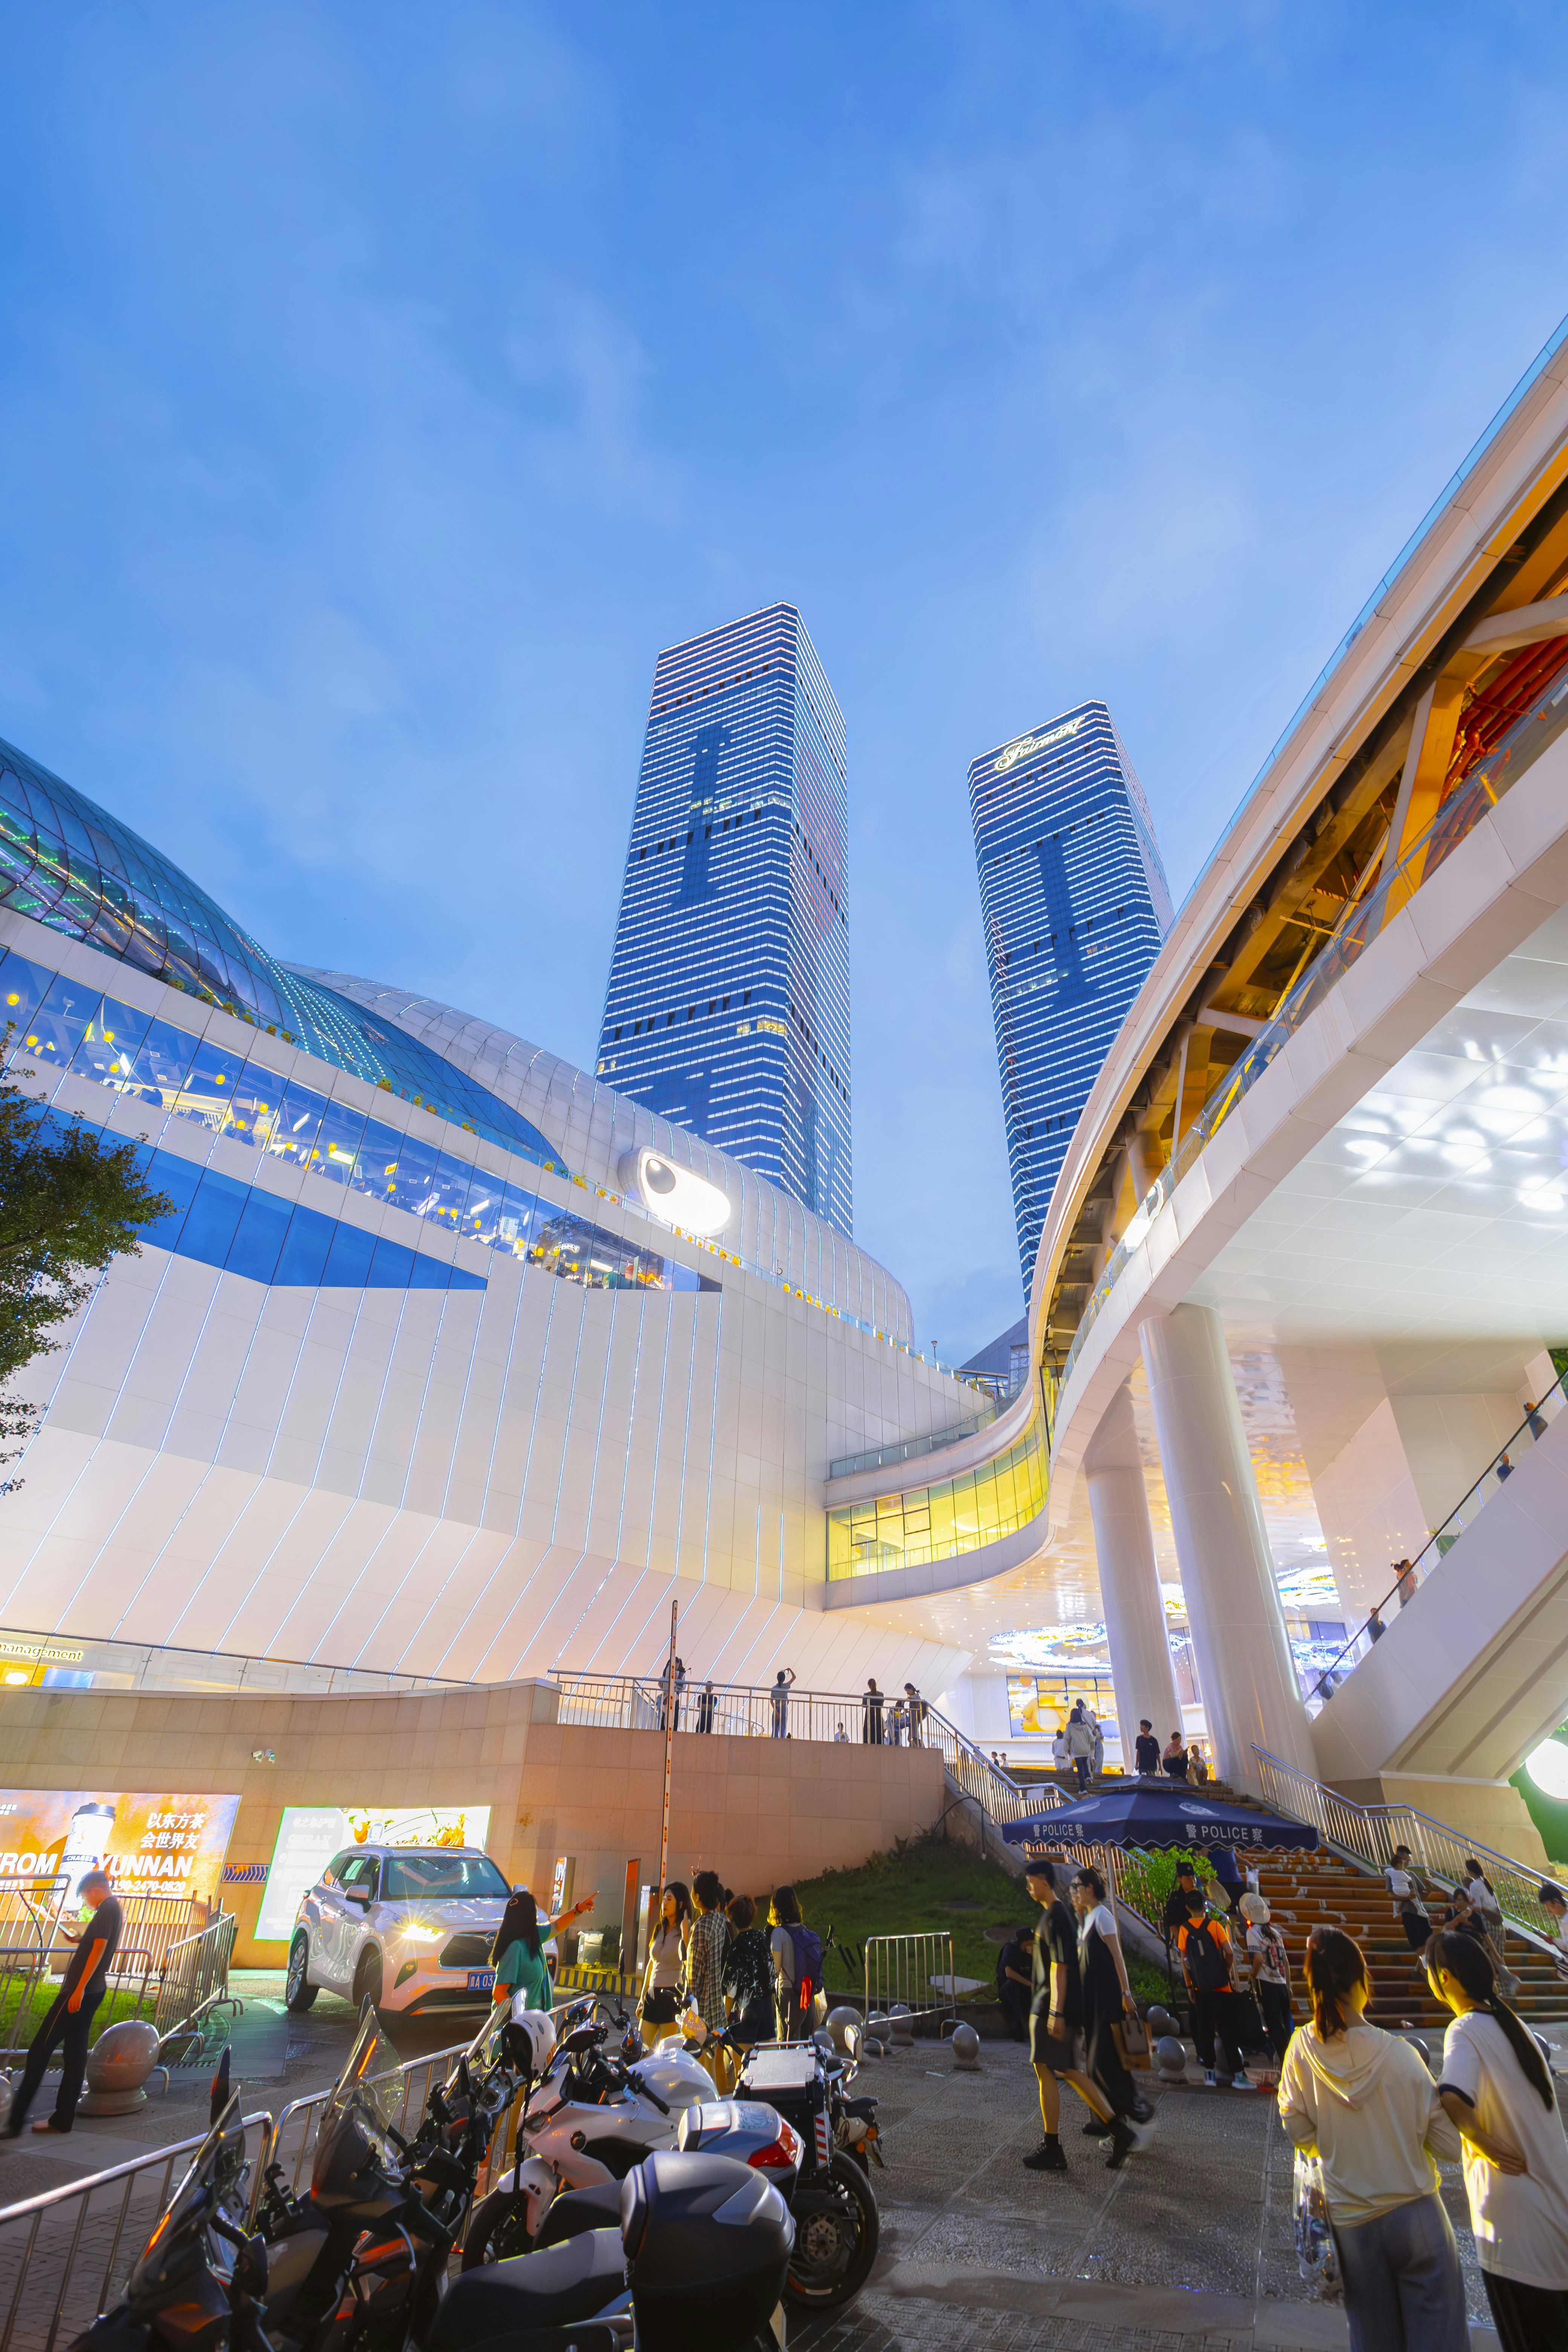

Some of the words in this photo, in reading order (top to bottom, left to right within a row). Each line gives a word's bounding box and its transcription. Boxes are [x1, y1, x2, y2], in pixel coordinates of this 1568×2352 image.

[994, 715, 1085, 771] Fairmont
[146, 1812, 206, 1829] 以东方茶
[1033, 1824, 1040, 1837] 警
[1043, 1824, 1074, 1836] POLICE
[1075, 1824, 1084, 1837] 察
[1185, 1824, 1197, 1839] 警
[1201, 1825, 1248, 1840] POLICE
[1252, 1828, 1263, 1842] 察
[140, 1831, 201, 1849] 会世界友
[0, 1852, 58, 1874] ROM
[97, 1854, 193, 1877] YUNNAN
